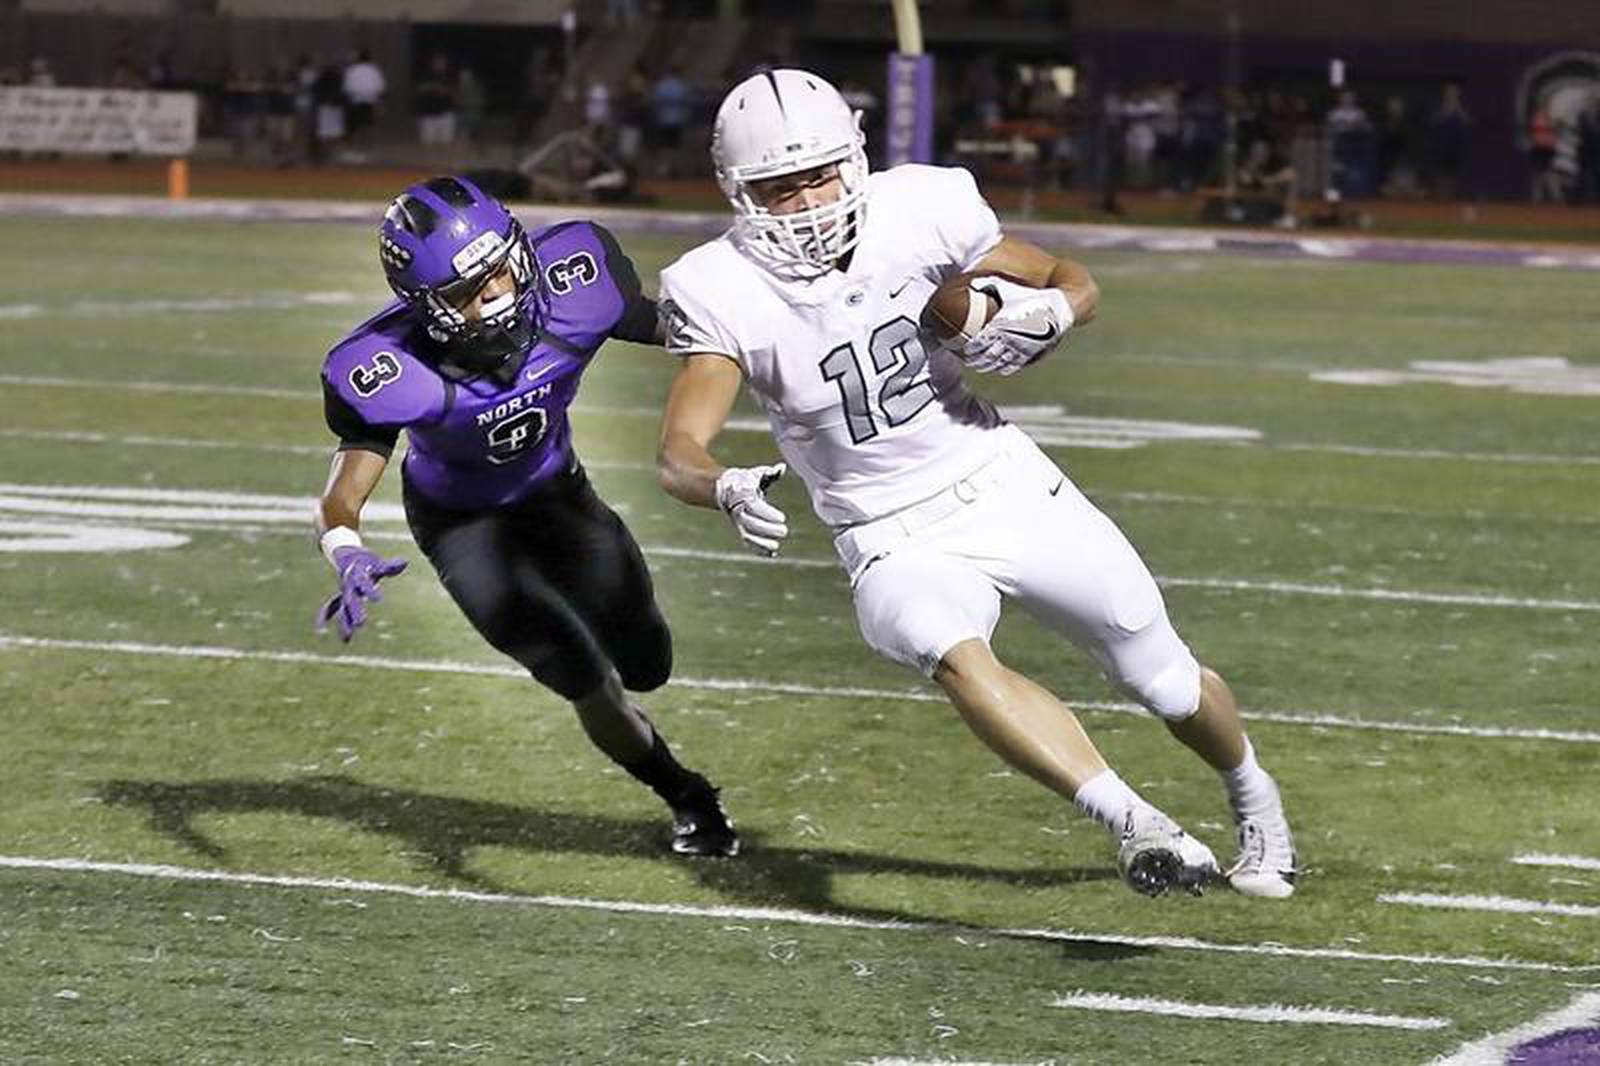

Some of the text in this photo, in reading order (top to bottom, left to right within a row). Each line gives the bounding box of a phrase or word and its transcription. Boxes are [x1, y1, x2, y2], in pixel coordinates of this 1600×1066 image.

[545, 251, 598, 295] 3
[349, 351, 402, 397] 3
[818, 314, 938, 445] 12
[475, 383, 552, 426] NORTH
